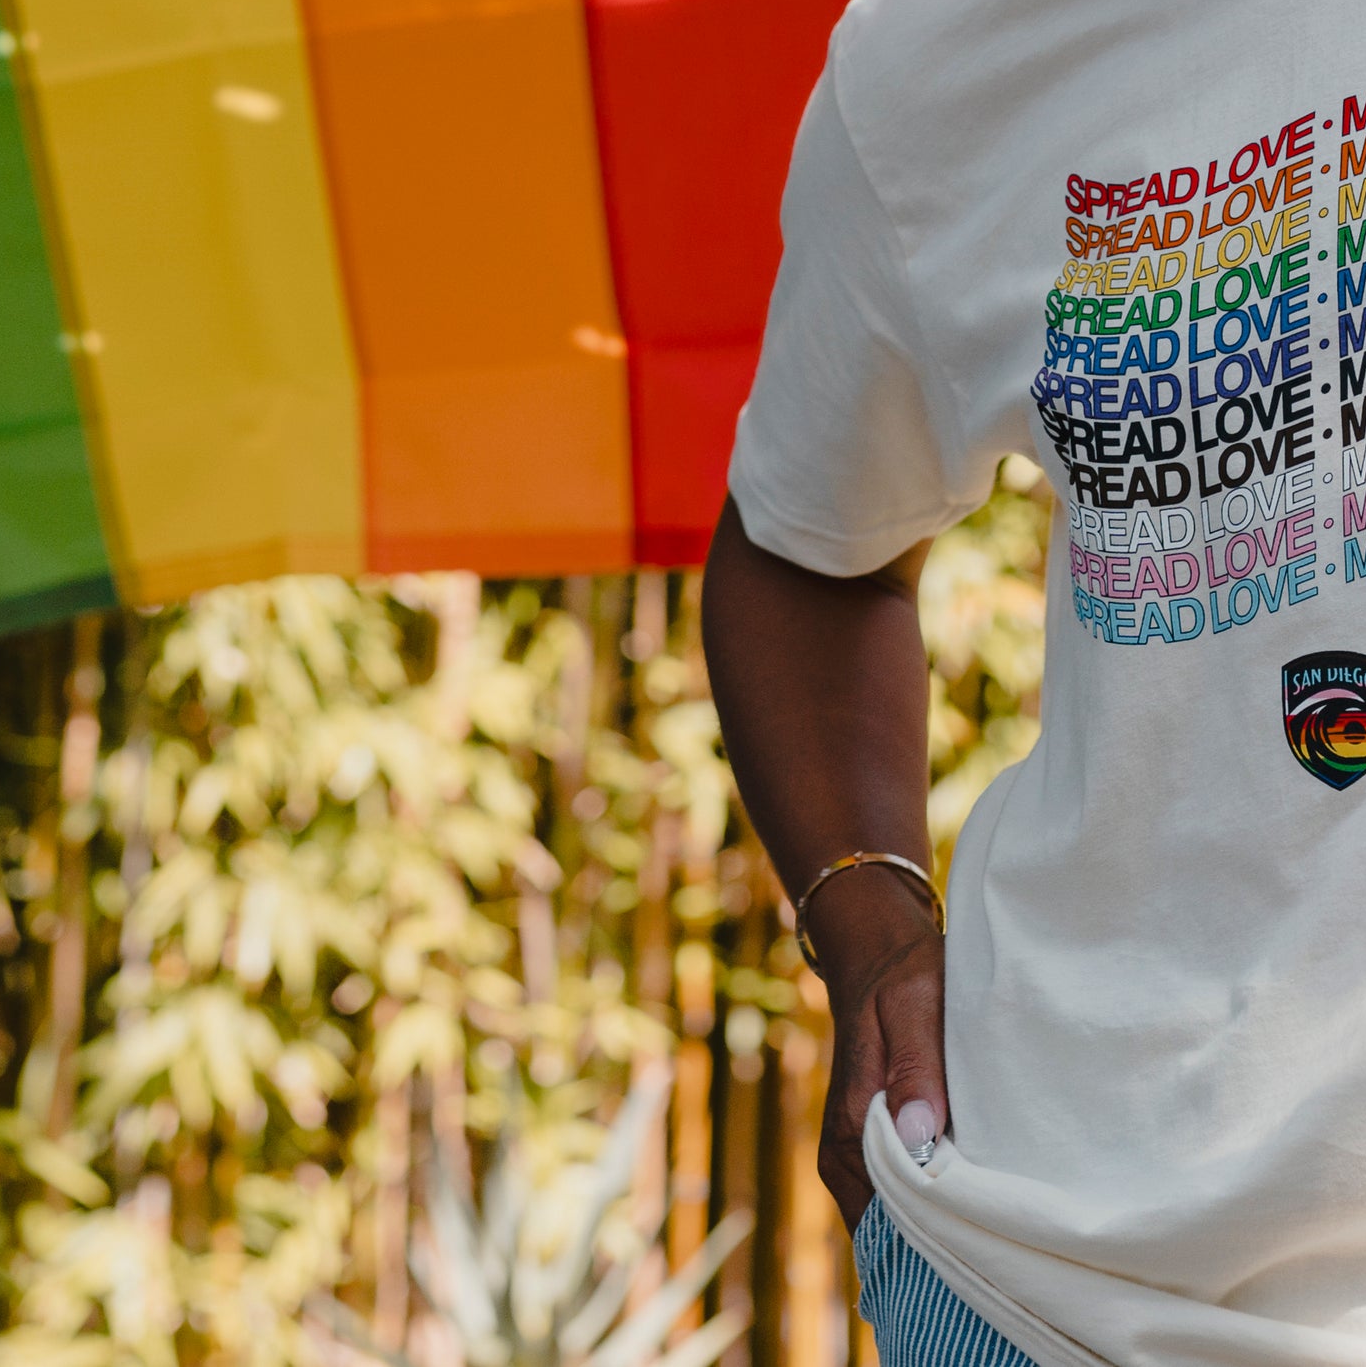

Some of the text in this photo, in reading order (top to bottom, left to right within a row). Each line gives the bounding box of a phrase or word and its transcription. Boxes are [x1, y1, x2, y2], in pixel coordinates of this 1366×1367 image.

[1065, 167, 1199, 220] SPREAD
[1205, 111, 1315, 197] LOVE
[1066, 210, 1194, 260] SPREAD
[1198, 156, 1313, 239] LOVE
[1045, 289, 1182, 335] SPREAD
[1189, 242, 1310, 321] LOVE
[1055, 251, 1187, 295] SPREAD
[1193, 200, 1311, 280] LOVE
[1030, 367, 1182, 420] SPREAD
[1189, 328, 1312, 409] LOVE
[1044, 326, 1180, 376] SPREAD
[1188, 284, 1310, 364] LOVE
[1191, 373, 1314, 453] LOVE
[1197, 418, 1315, 498] LOVE
[1069, 499, 1195, 554] PREAD
[1201, 463, 1315, 542] LOVE
[1205, 509, 1316, 589] LOVE
[1210, 554, 1318, 634] LOVE
[1293, 668, 1321, 695] SAN
